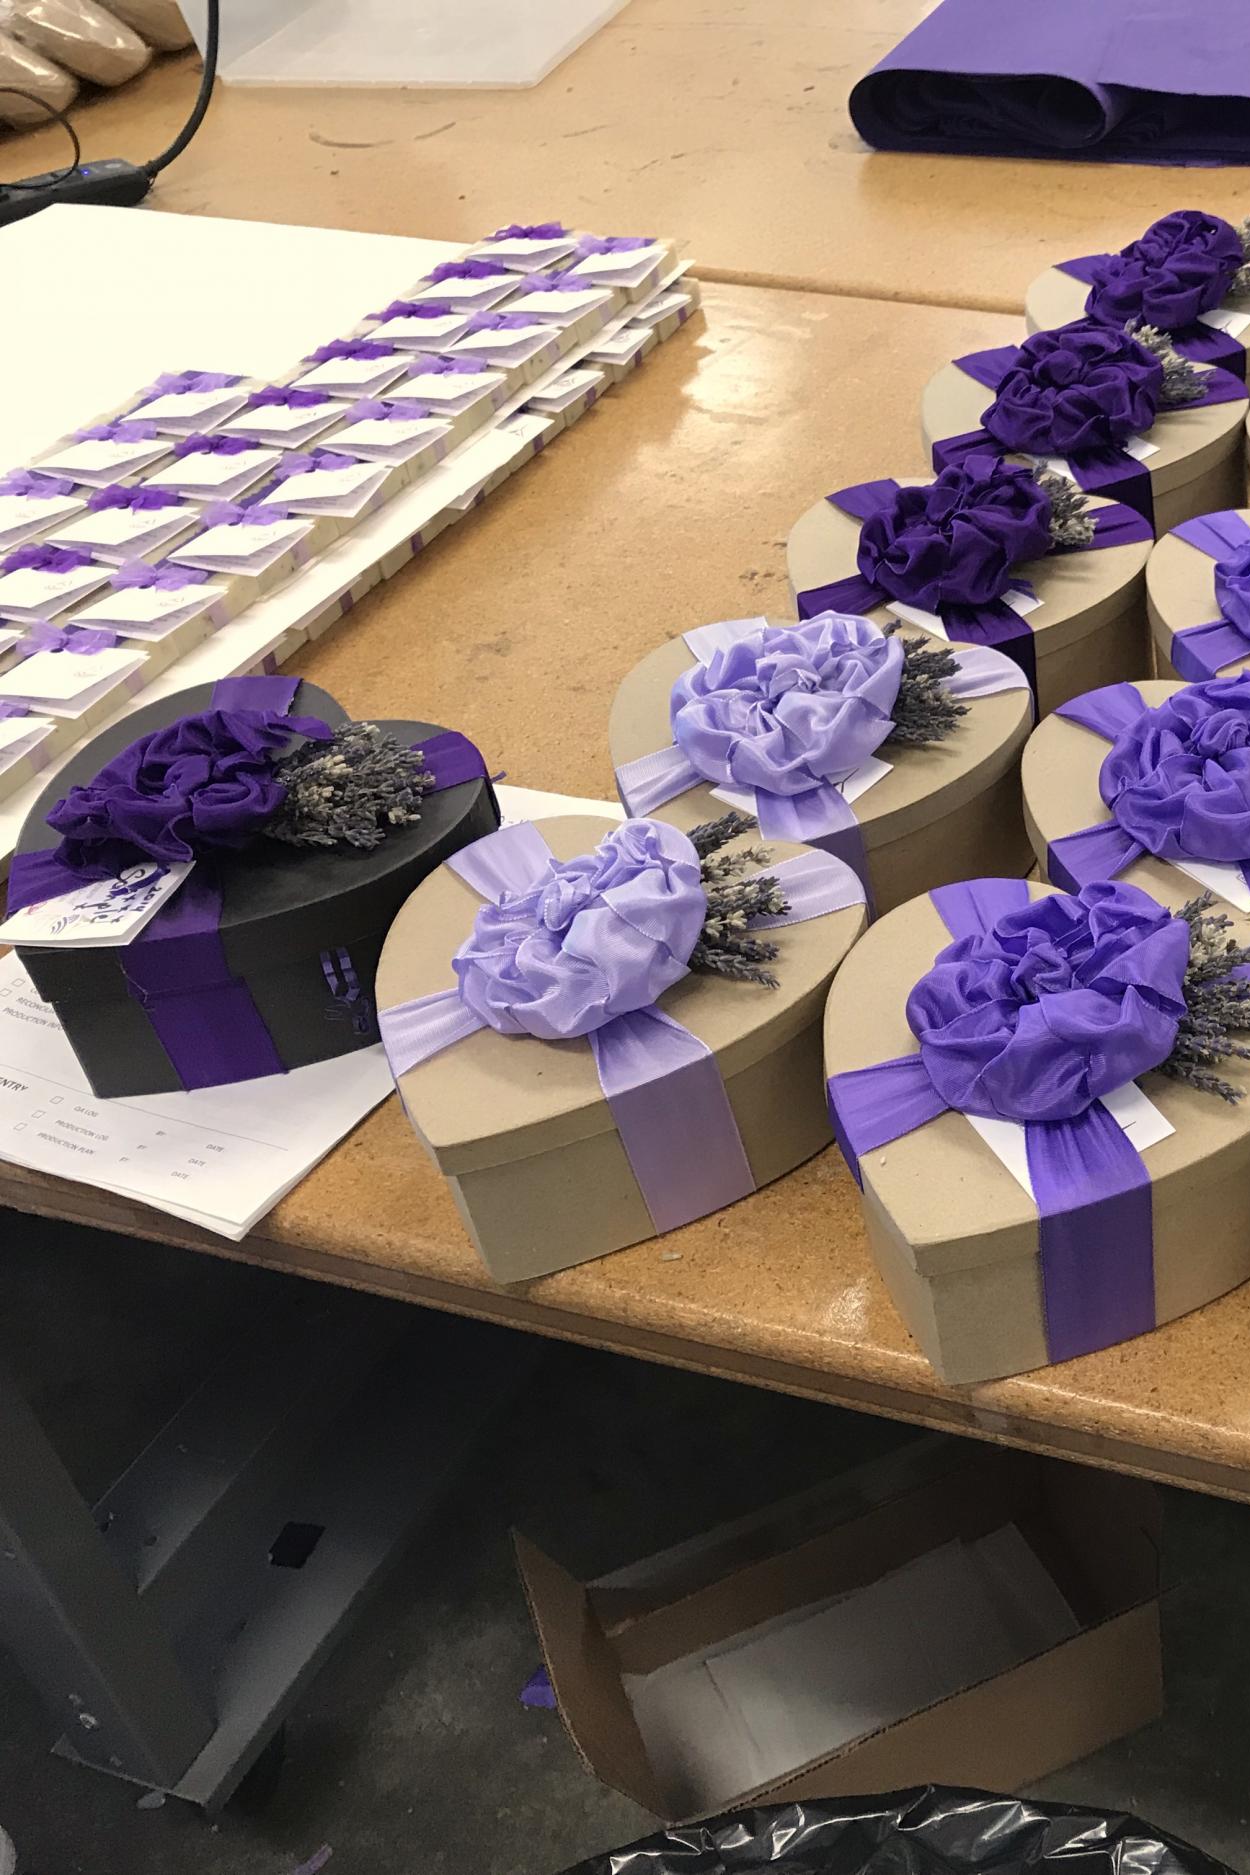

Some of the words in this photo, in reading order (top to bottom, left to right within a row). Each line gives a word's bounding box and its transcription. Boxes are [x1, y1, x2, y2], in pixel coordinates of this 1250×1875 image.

[130, 886, 162, 912] 2014
[3, 1007, 47, 1025] PRODUCTION
[37, 1132, 78, 1151] PRODUCTION
[170, 1170, 190, 1180] DATE
[55, 1119, 96, 1137] PRODUCTION
[187, 1158, 207, 1167] DATE
[205, 1143, 225, 1152] DATE
